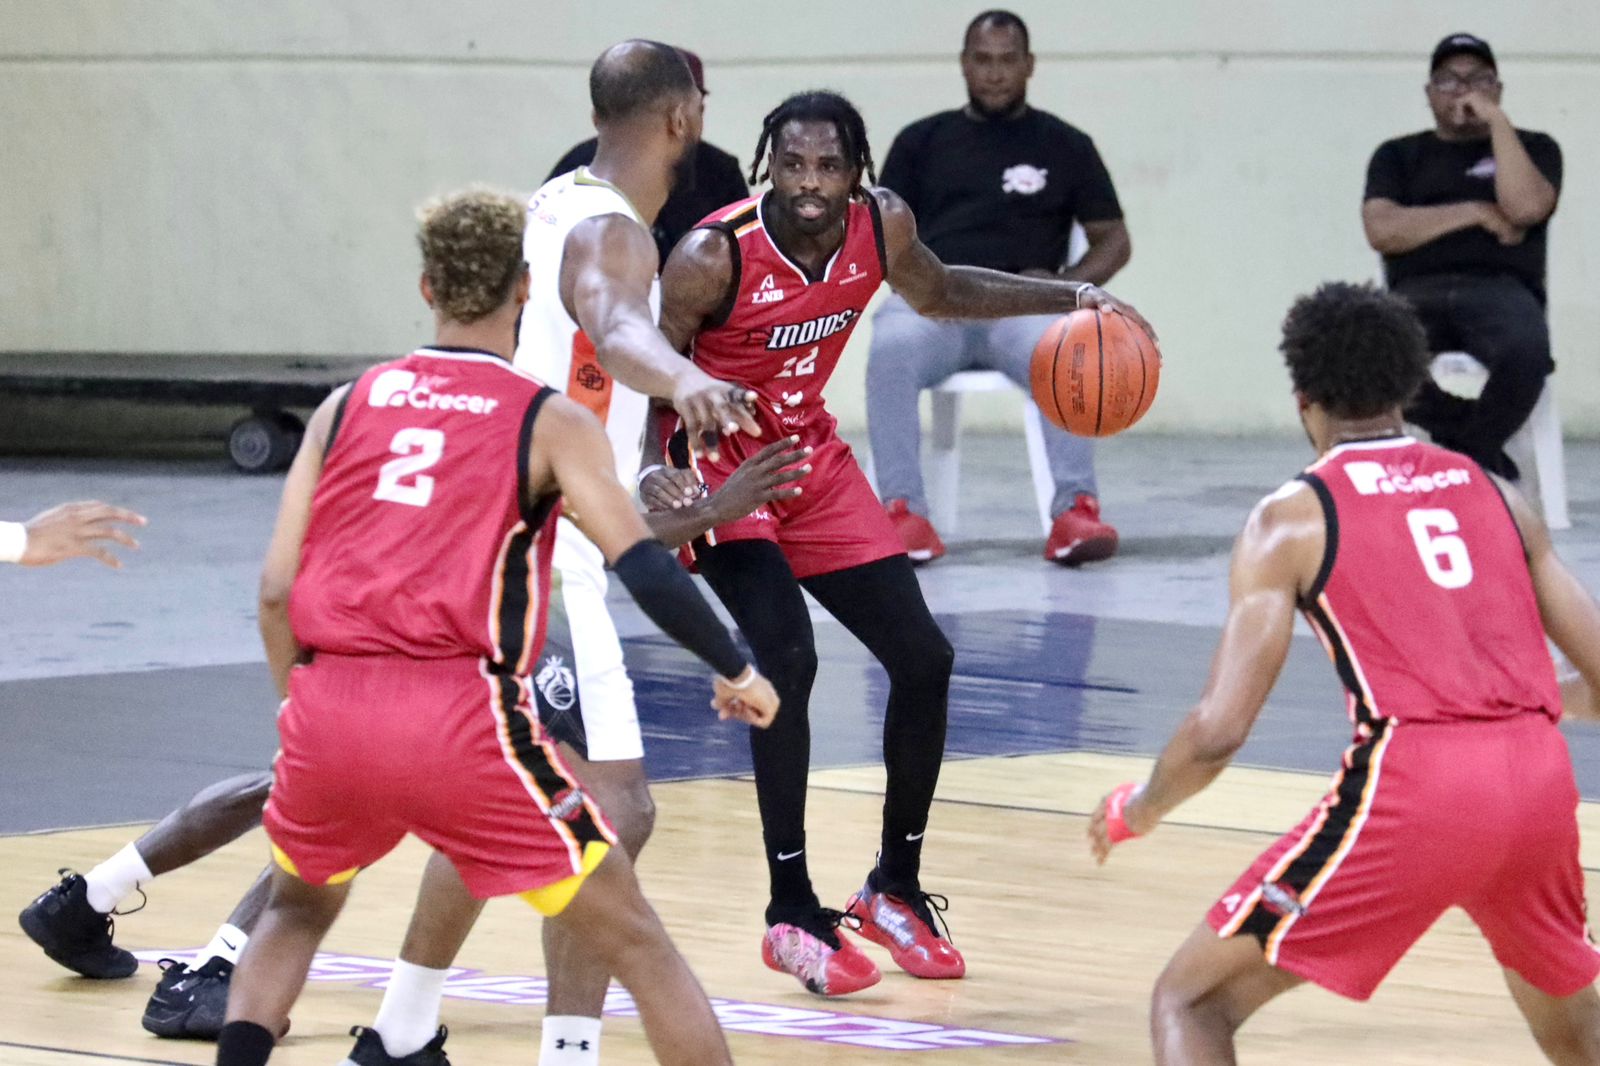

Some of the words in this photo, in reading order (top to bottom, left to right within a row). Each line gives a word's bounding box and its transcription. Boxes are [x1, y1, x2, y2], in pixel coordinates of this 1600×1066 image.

[751, 289, 784, 304] LNB
[407, 386, 499, 415] Crecer
[371, 426, 446, 508] 2
[1405, 507, 1475, 590] 6
